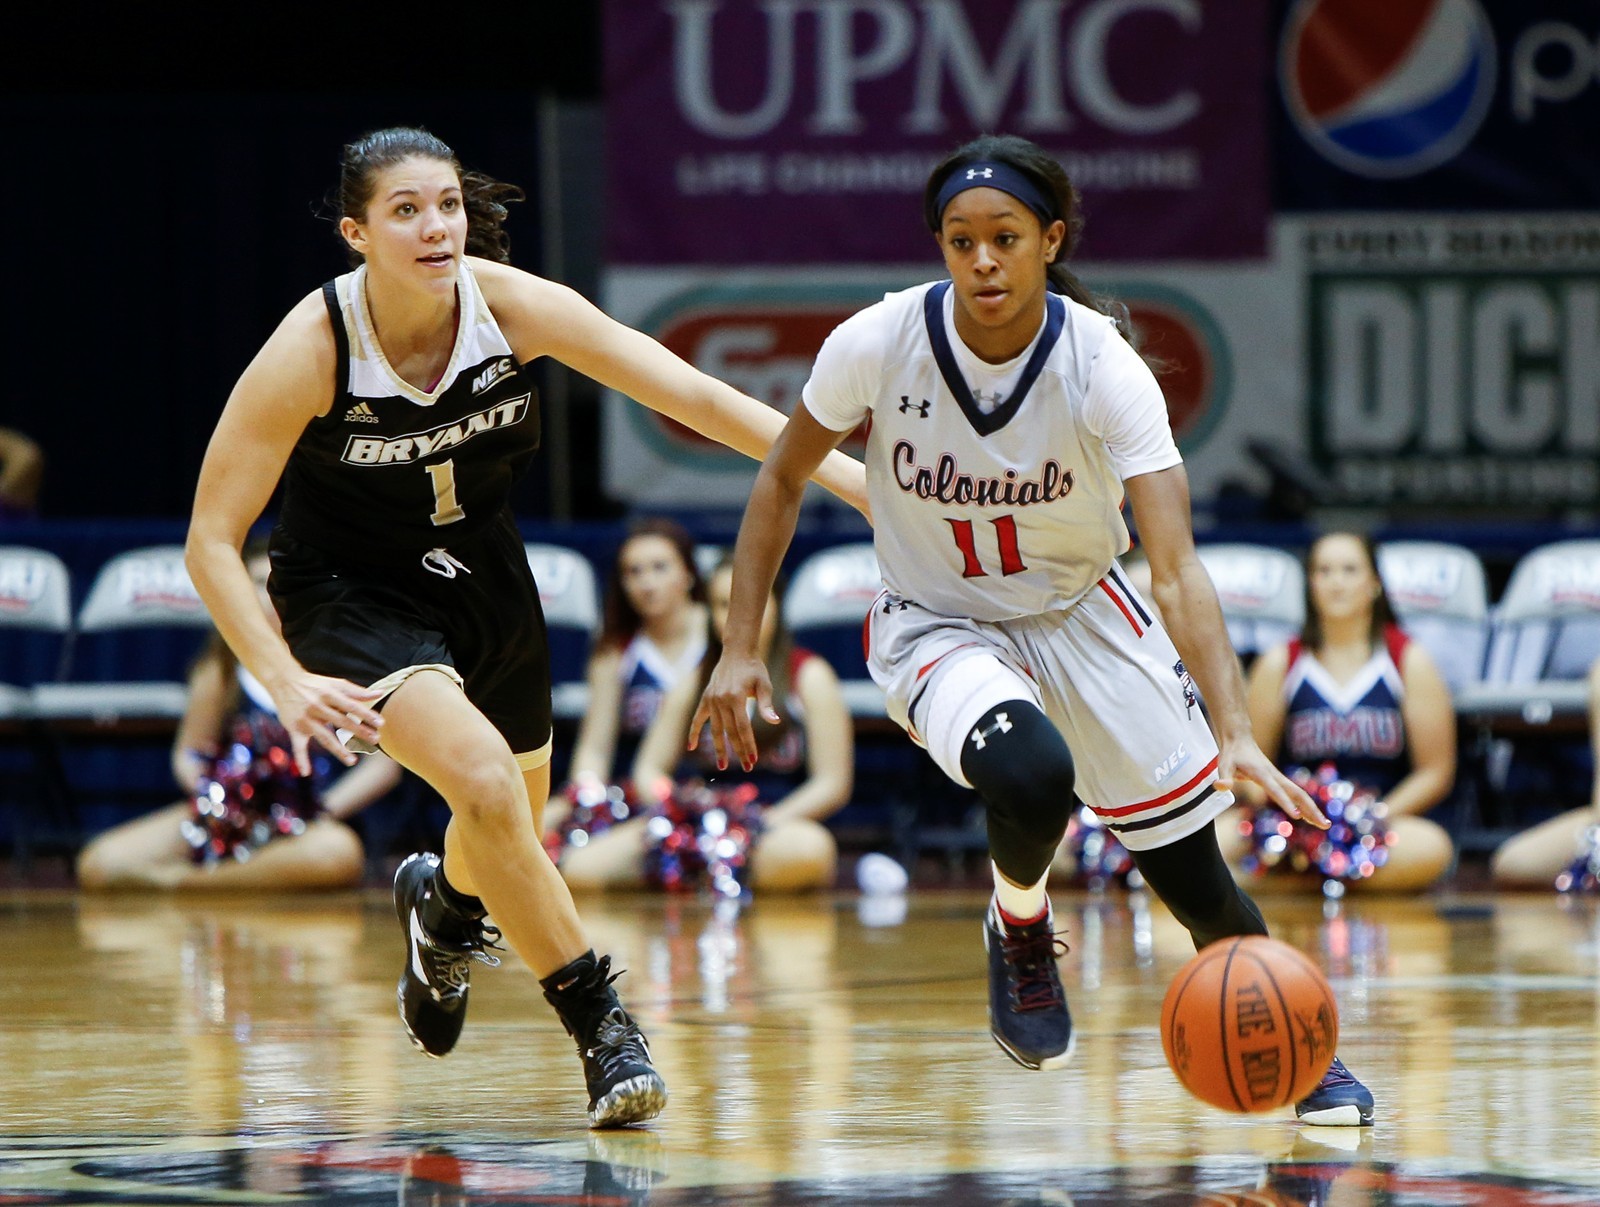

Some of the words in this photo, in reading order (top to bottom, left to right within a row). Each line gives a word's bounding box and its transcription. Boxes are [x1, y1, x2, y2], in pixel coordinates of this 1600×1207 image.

[669, 0, 1200, 138] UPMC
[1513, 20, 1600, 122] p
[472, 359, 512, 394] NEC
[346, 397, 526, 464] BRYANT
[425, 458, 466, 526] 1
[893, 439, 1076, 507] Colonials
[943, 515, 1028, 578] 11
[1154, 742, 1187, 782] NEC
[1289, 708, 1400, 760] RMU
[1236, 981, 1276, 1039] THE
